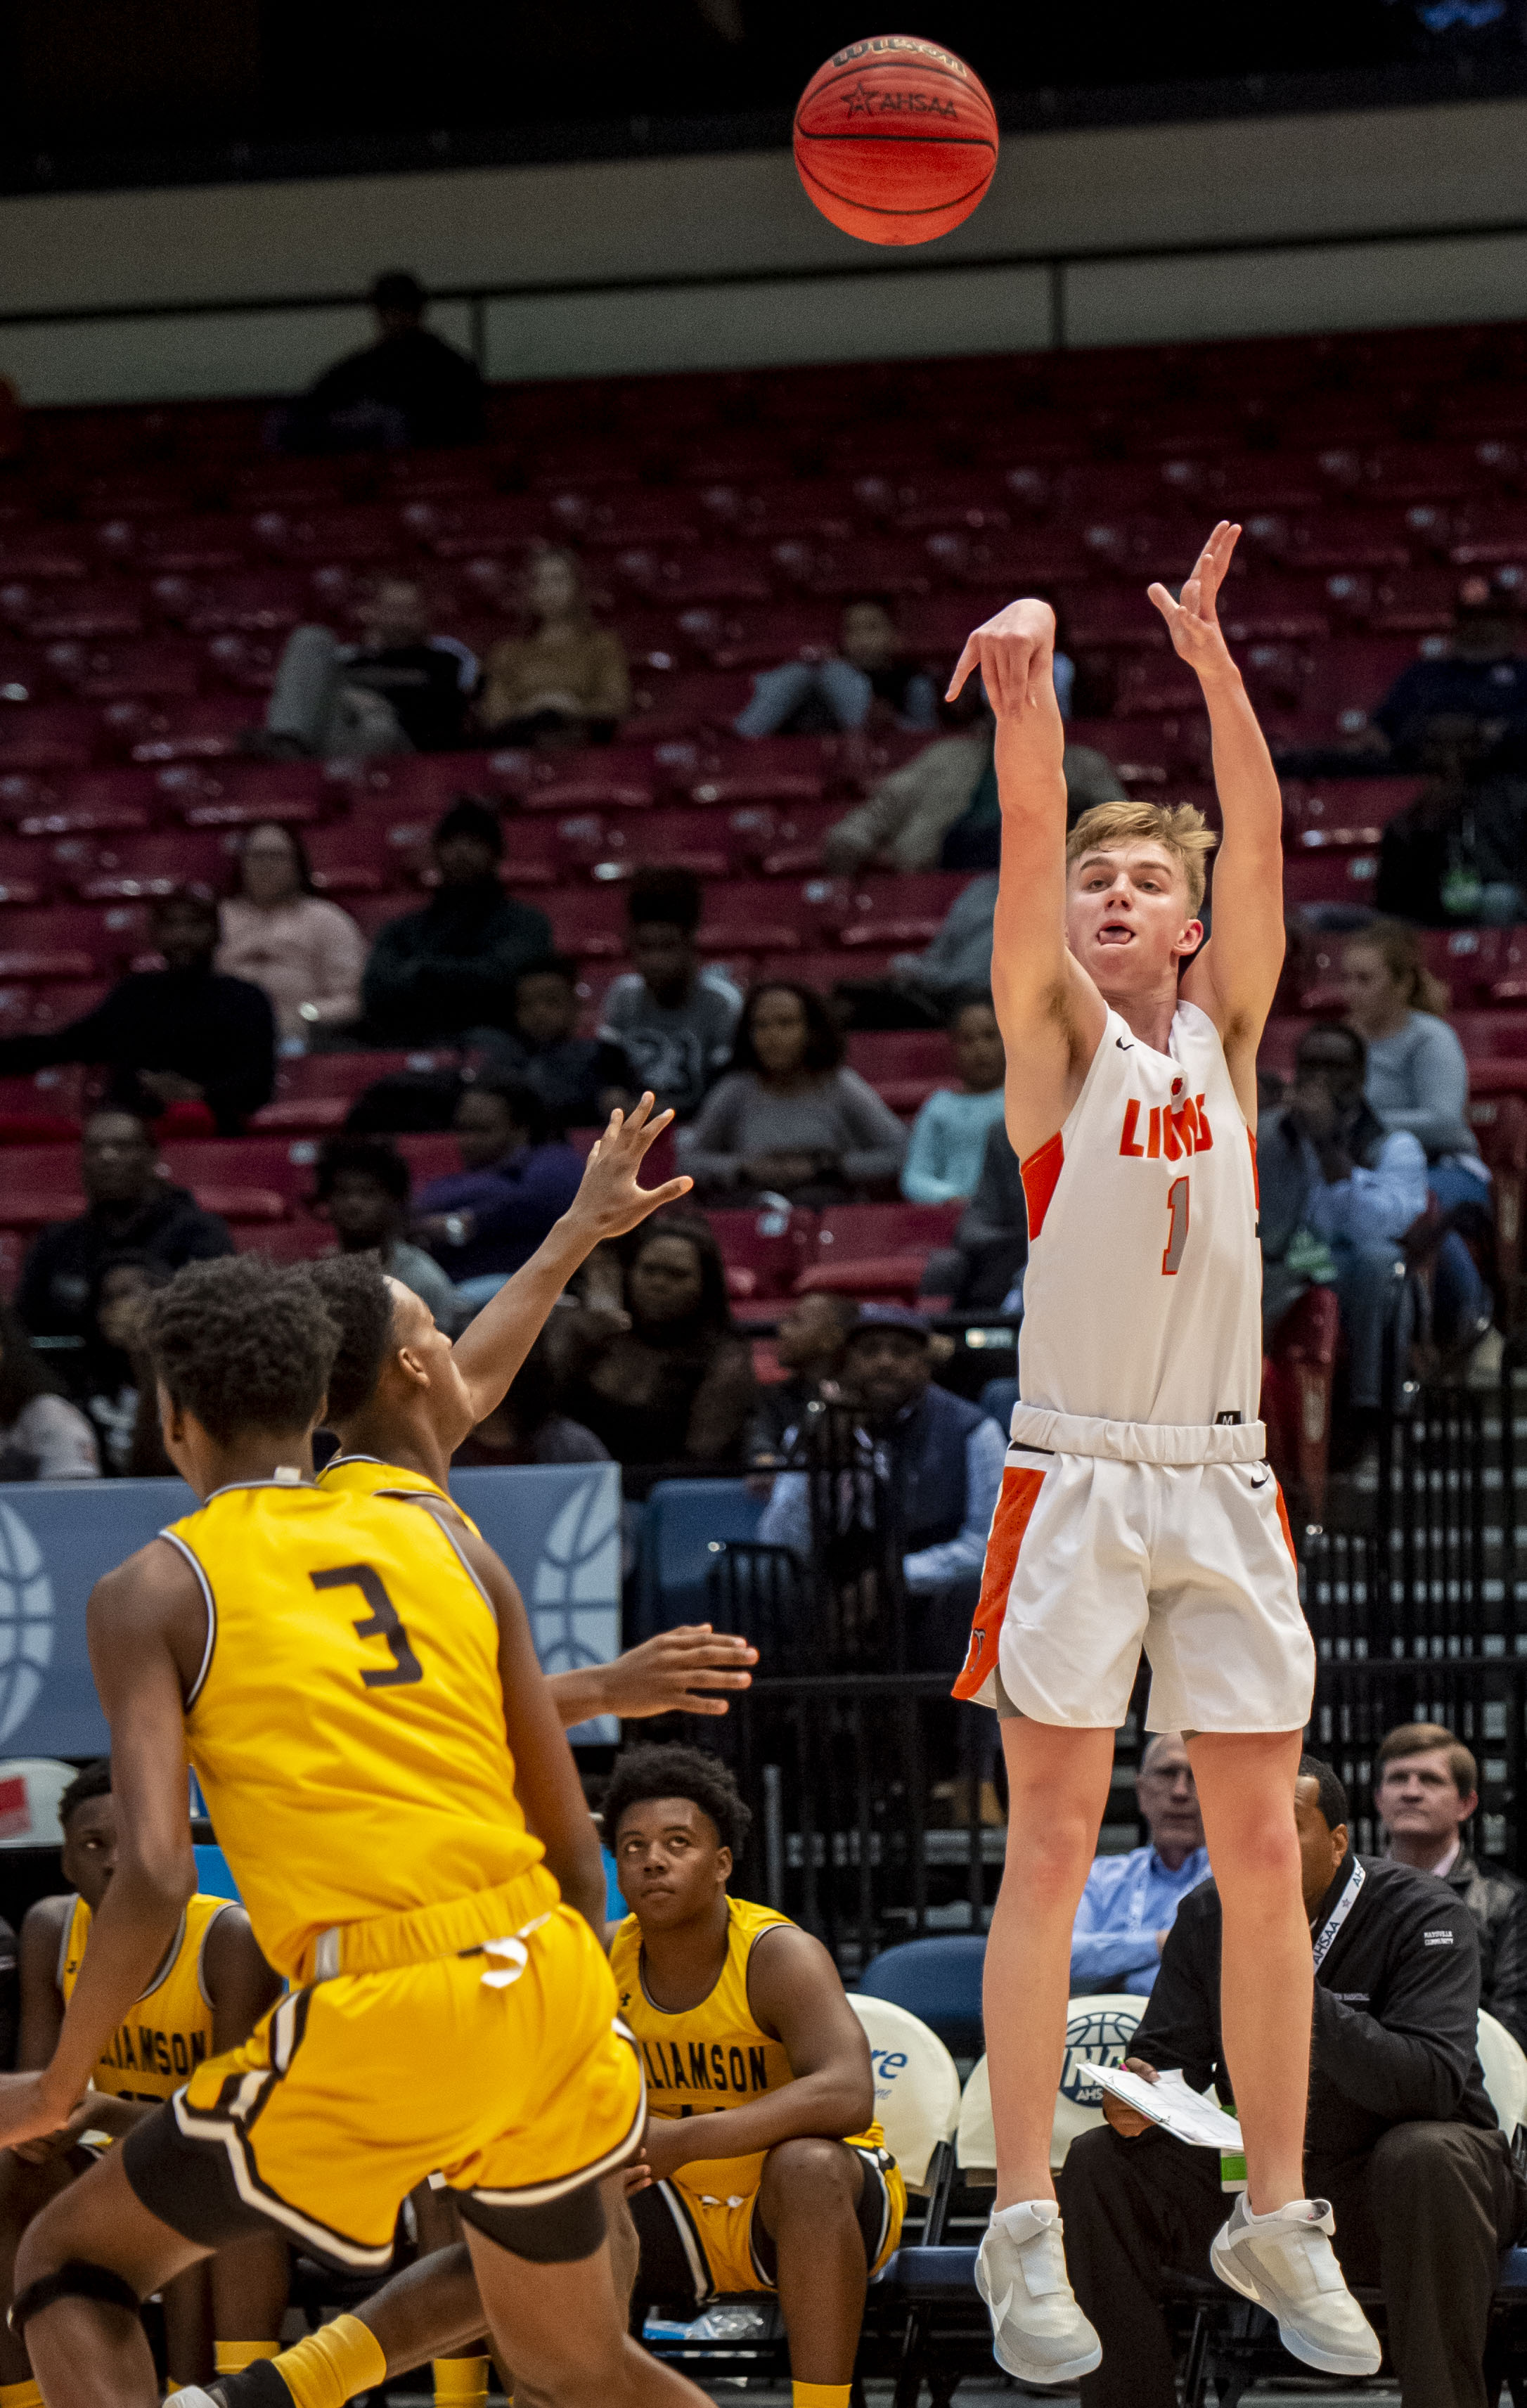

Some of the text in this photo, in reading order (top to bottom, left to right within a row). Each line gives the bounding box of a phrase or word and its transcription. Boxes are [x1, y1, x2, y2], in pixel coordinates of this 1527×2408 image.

[880, 92, 958, 118] AHSAA
[1161, 1175, 1190, 1275] 1
[308, 1564, 423, 1689] 3
[1313, 1921, 1341, 1966] AHSAA
[100, 2025, 206, 2075] IAMSON
[641, 2042, 768, 2092] LIAMSON
